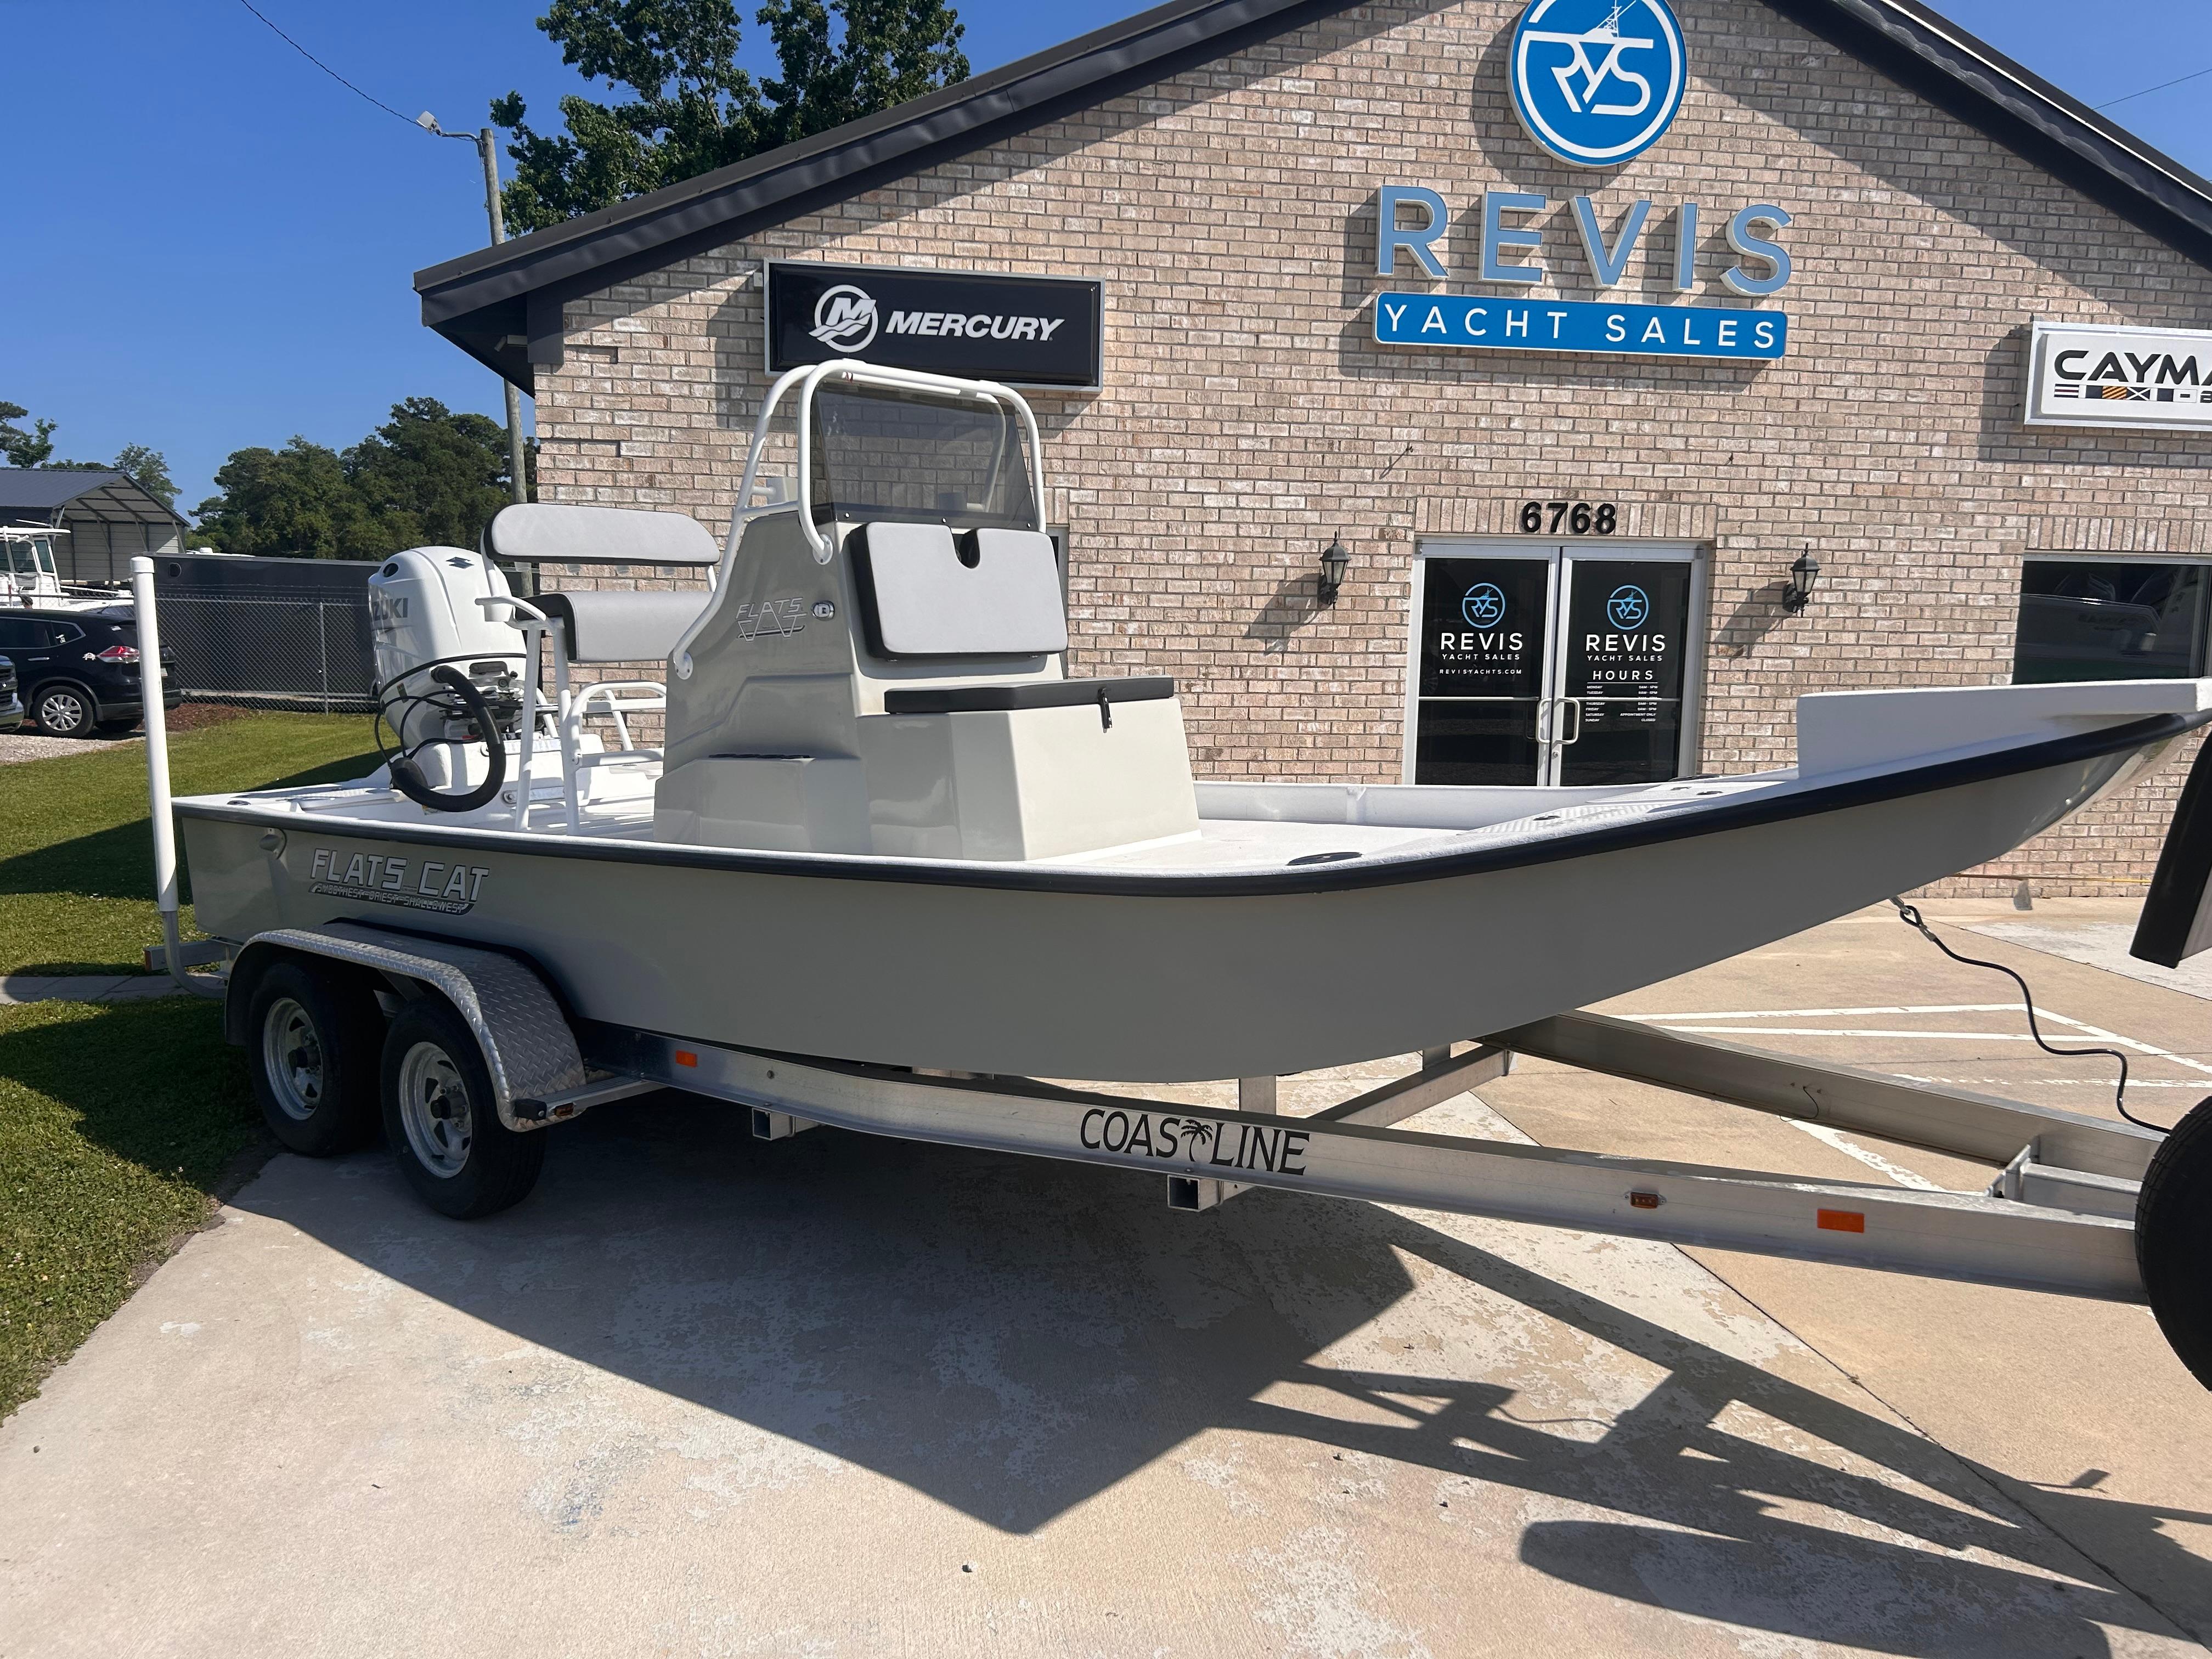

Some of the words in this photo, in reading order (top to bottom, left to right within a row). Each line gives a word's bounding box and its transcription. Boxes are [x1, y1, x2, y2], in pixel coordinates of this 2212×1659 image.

[1374, 185, 1792, 297] REVIS
[885, 311, 1065, 341] MERCURY
[1385, 304, 1567, 339] YACHT
[1605, 314, 1775, 348] SALES
[1522, 501, 1616, 534] 6768
[735, 597, 803, 620] FLATS
[1441, 633, 1523, 651] REVIS
[1585, 634, 1666, 652] REVIS
[1593, 670, 1653, 680] HOURS
[311, 848, 408, 891] FLATS
[417, 861, 490, 903] CAT
